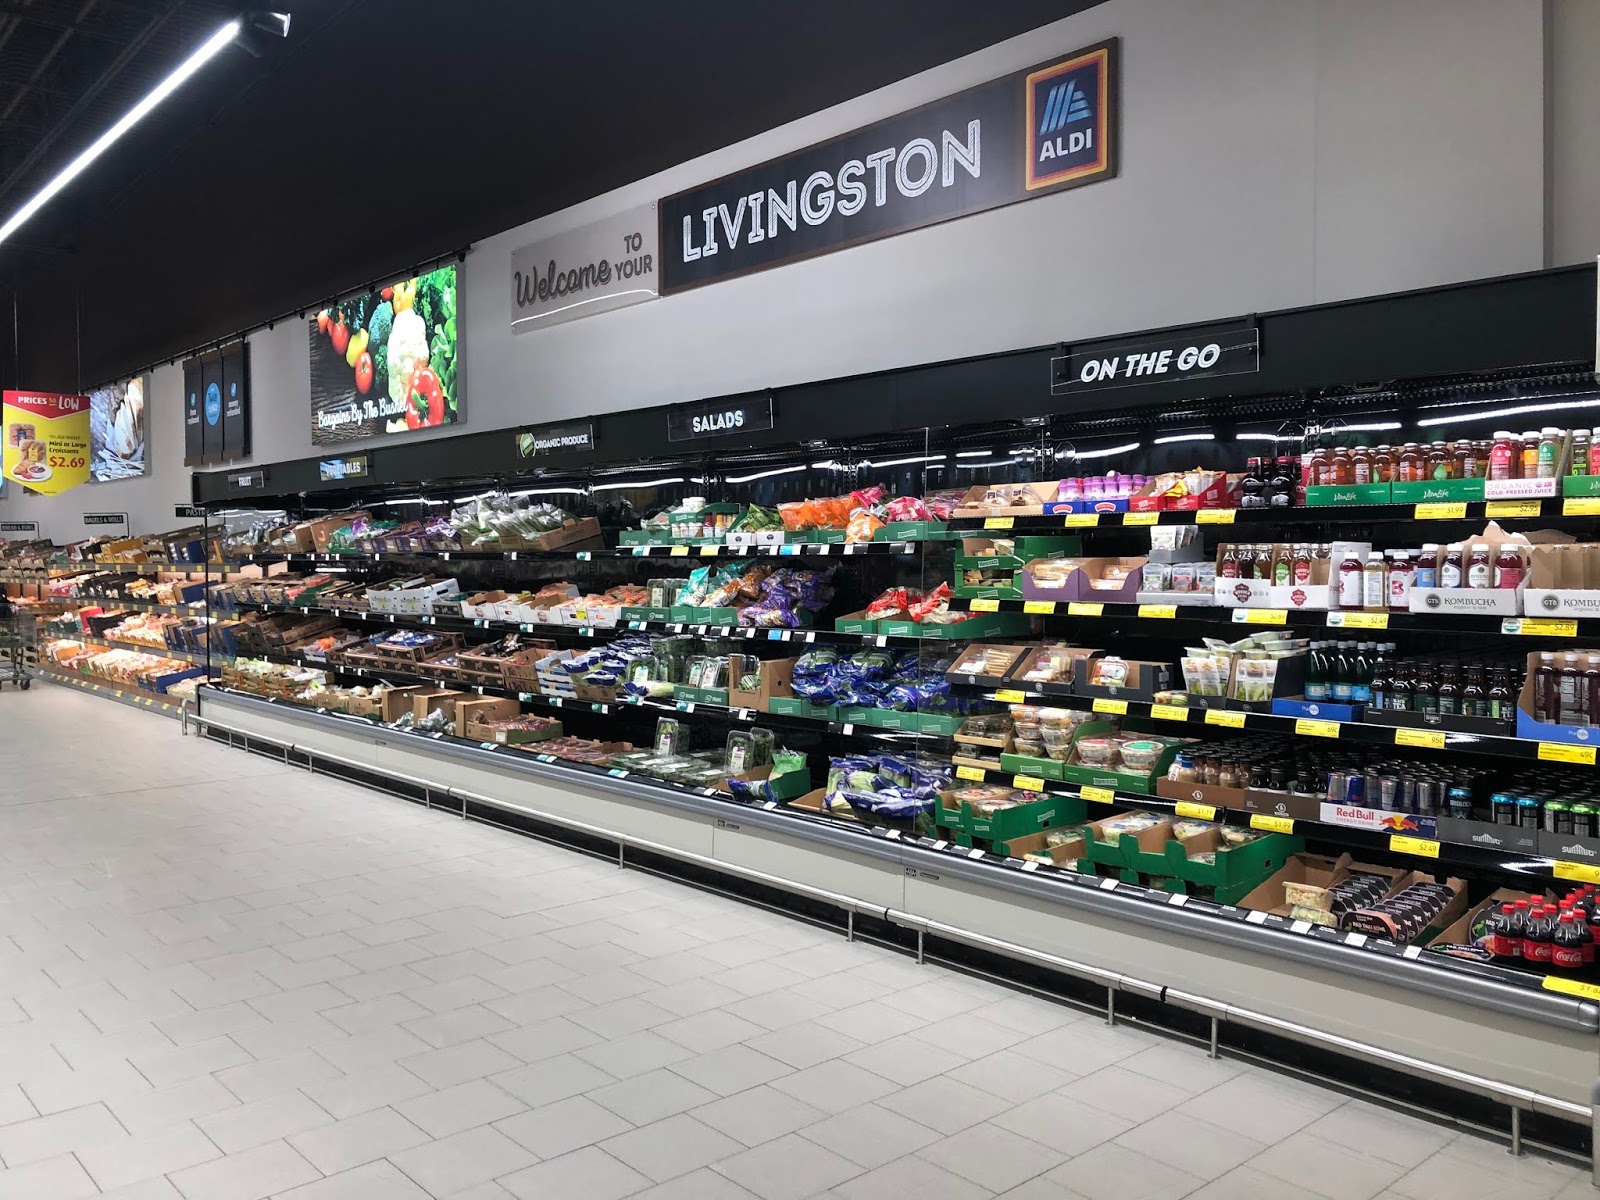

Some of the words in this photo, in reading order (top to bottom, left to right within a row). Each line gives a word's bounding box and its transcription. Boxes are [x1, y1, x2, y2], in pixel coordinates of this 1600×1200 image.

[1039, 128, 1093, 162] ALDI
[683, 118, 982, 263] LIVINGSTON
[624, 232, 643, 254] TO
[614, 254, 653, 281] YOUR
[514, 259, 612, 309] Welcome
[1080, 357, 1120, 383] ON
[1125, 349, 1174, 377] THE
[1177, 343, 1221, 371] GO
[18, 396, 48, 405] PRICES
[58, 395, 80, 411] LOW
[350, 403, 363, 426] By
[363, 400, 379, 420] The
[692, 410, 744, 433] SALADS
[535, 437, 561, 450] ORGANIC
[561, 433, 589, 447] PRODUCE
[49, 456, 86, 468] $2.69
[1487, 482, 1533, 490] ORGANIC
[1447, 506, 1464, 514] $1.99
[1519, 505, 1539, 513] $2.95
[1444, 597, 1497, 606] KOMBUCHA
[1336, 807, 1355, 818] Red
[1356, 810, 1374, 821] Bull
[1419, 843, 1437, 852] $2.49
